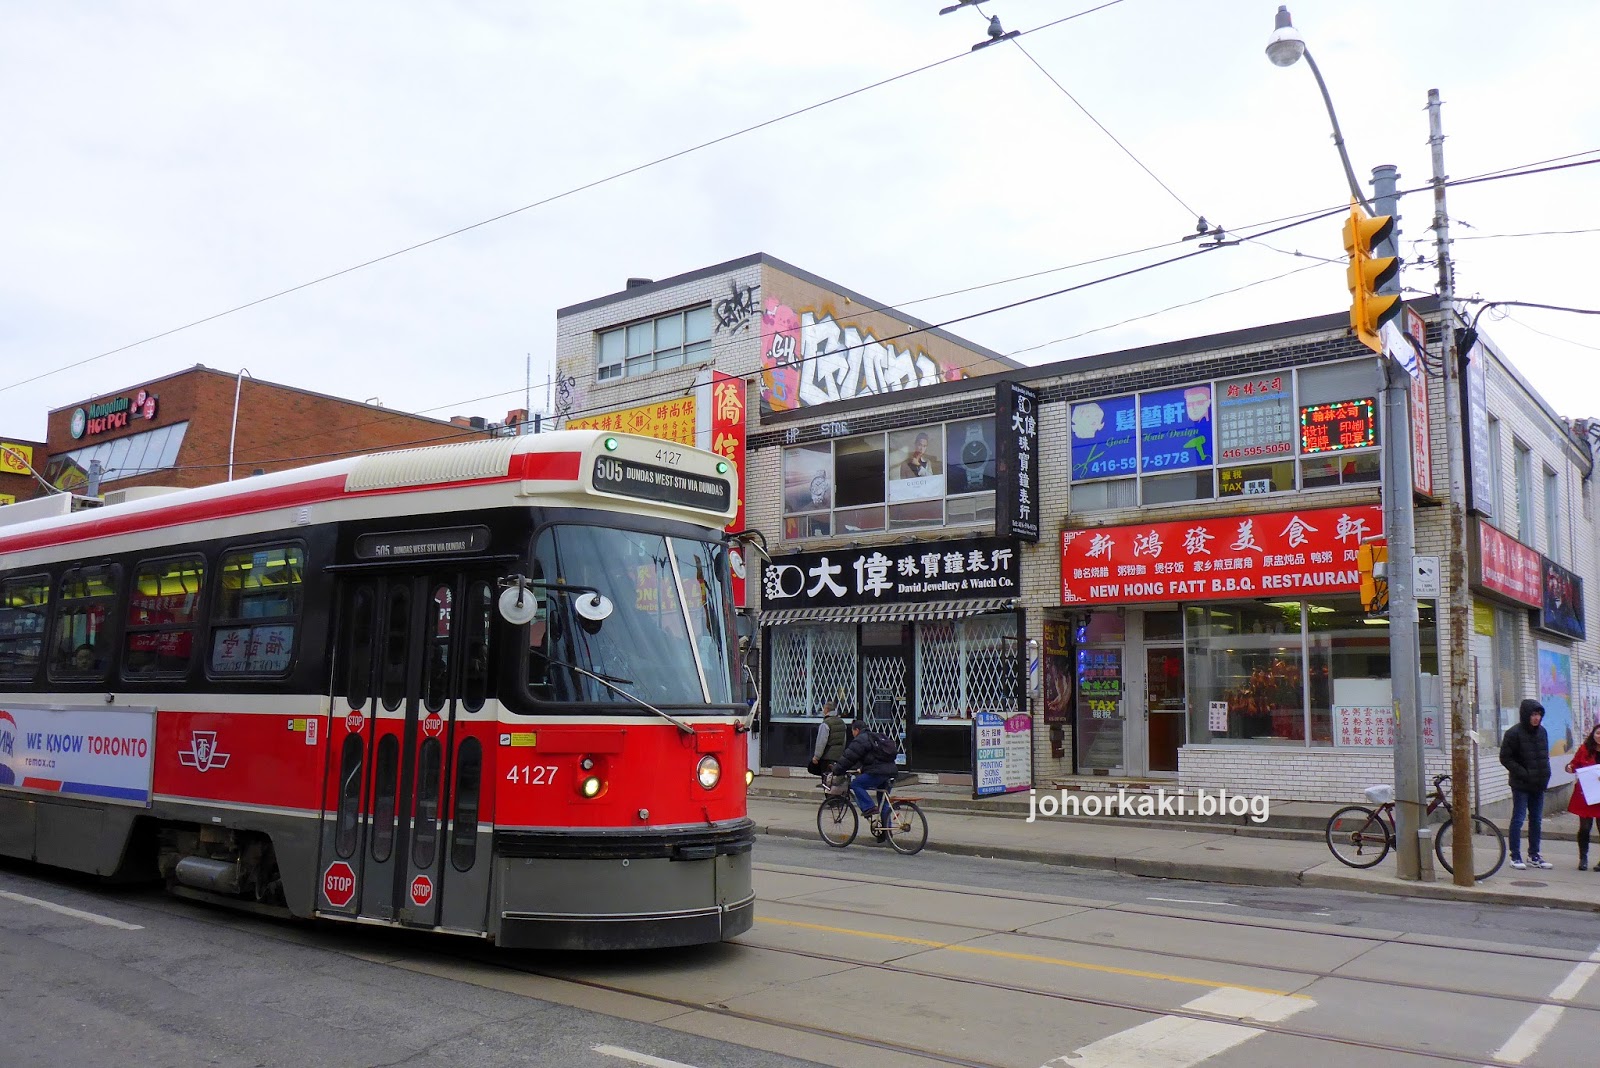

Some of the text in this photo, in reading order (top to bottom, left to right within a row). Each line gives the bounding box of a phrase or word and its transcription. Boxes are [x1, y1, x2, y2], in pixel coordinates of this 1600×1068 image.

[89, 397, 129, 419] Mongolian
[1105, 428, 1199, 448] Good Hair Design
[655, 449, 682, 466] 4127
[1222, 442, 1291, 459] 416 595-5050
[1091, 451, 1190, 473] 416-597-8778
[597, 458, 724, 497] 505 DUNDAS WEST STN VIA DUNDAS
[1222, 483, 1242, 493] TAX
[375, 544, 391, 556] 505
[393, 545, 413, 555] DUNDAS
[413, 544, 427, 554] WEST
[807, 551, 894, 598] 大偉
[898, 575, 1014, 594] David Jewellery & Watch Co.
[1089, 570, 1361, 598] NEW HONG FATT B.B.Q. RESTAURAN
[1088, 700, 1116, 711] TAX
[348, 714, 364, 726] STOP
[425, 718, 441, 730] STOP
[27, 732, 148, 758] WE KNOW TORONTO
[979, 749, 994, 759] COPY
[980, 761, 1003, 769] PRINTING
[984, 768, 1000, 777] SIGNS
[506, 765, 559, 785] 4127
[981, 776, 1002, 785] STAMPS
[327, 876, 352, 892] STOP
[413, 883, 431, 898] STOP
